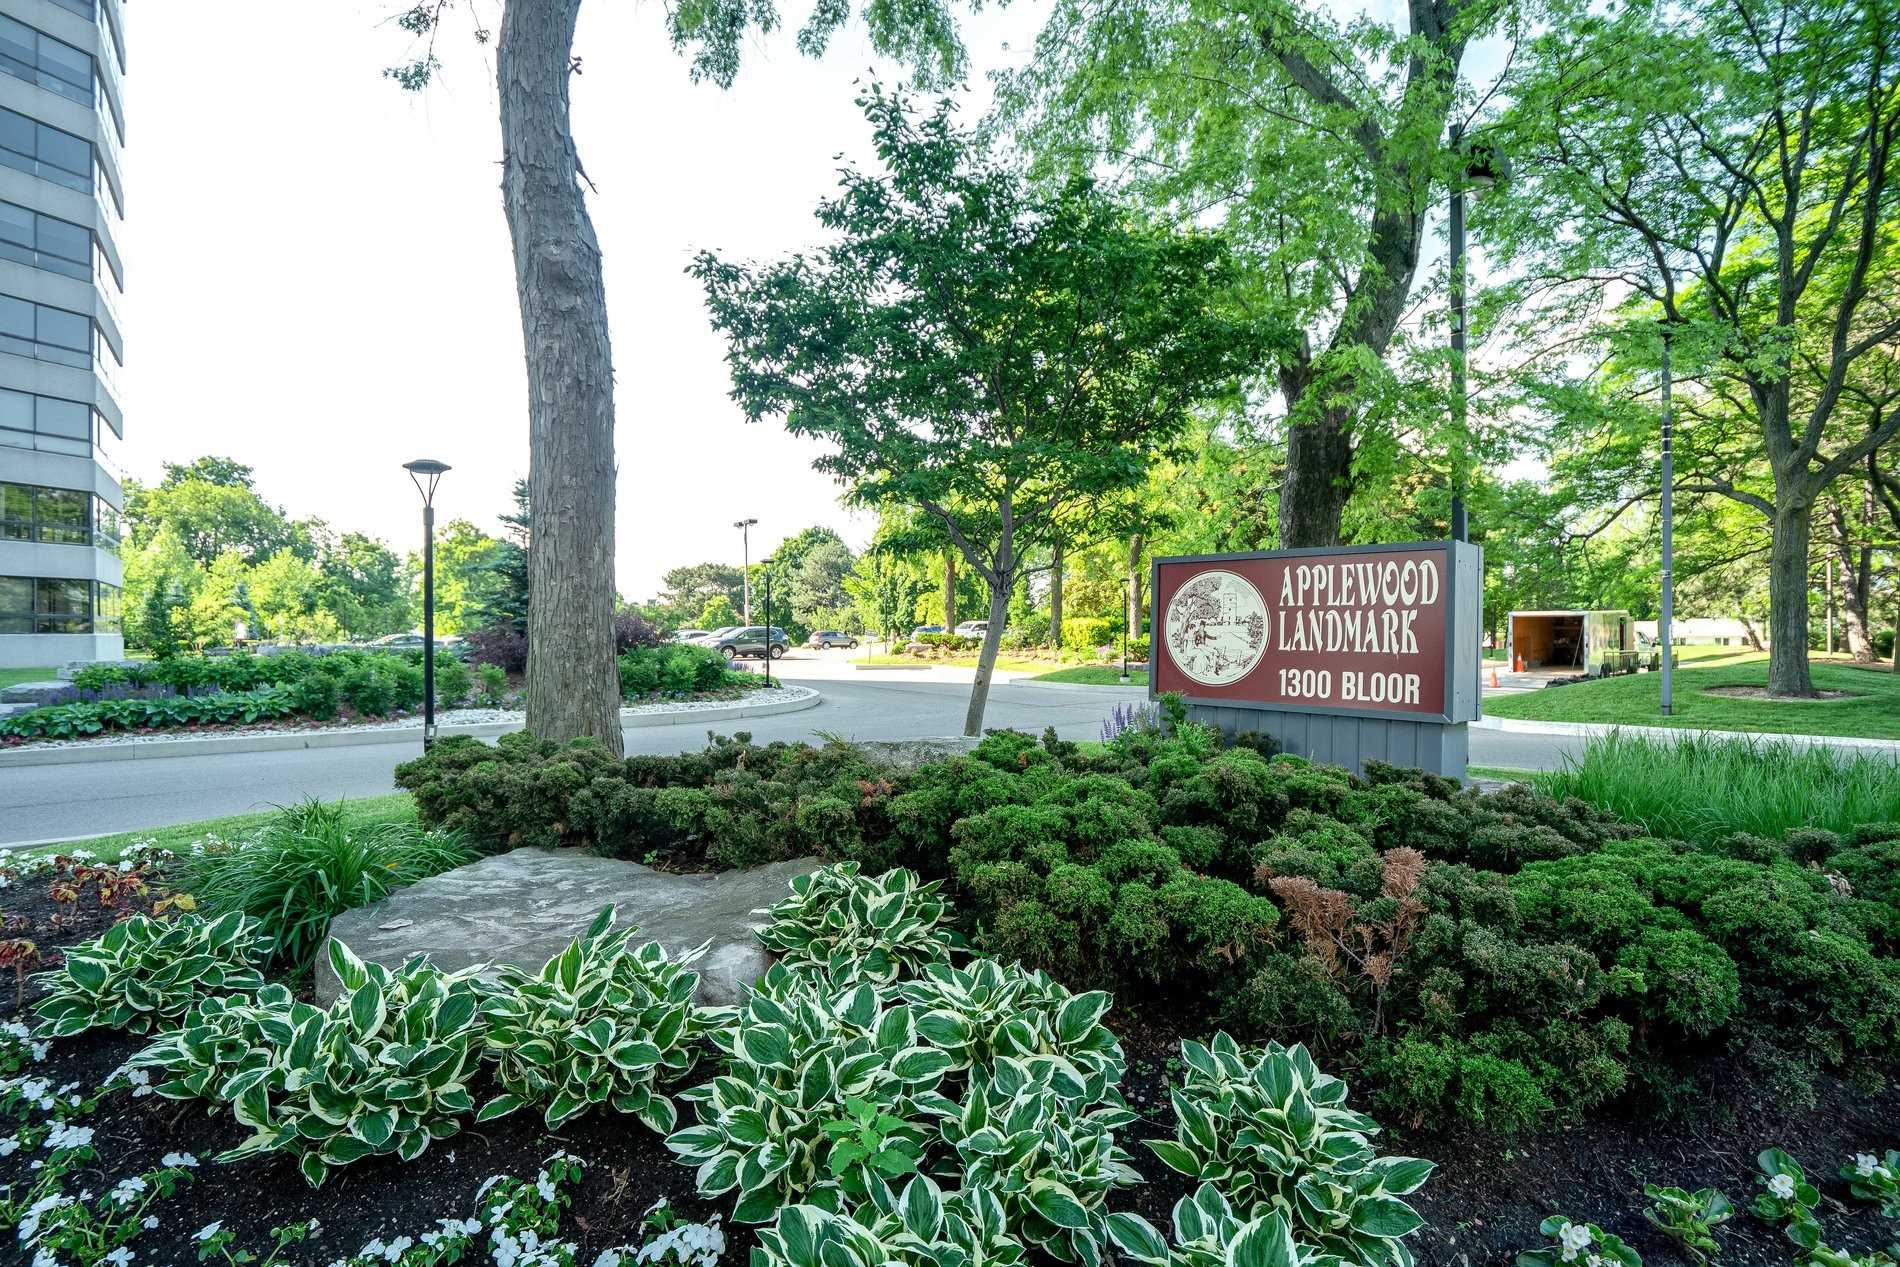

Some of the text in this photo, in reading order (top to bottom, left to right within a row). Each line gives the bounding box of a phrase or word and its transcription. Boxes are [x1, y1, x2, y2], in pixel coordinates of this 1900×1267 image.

[1279, 559, 1438, 606] APPLEWOOD
[1279, 608, 1419, 654] LANDMARK
[1279, 668, 1420, 704] 1300 BLOOR
